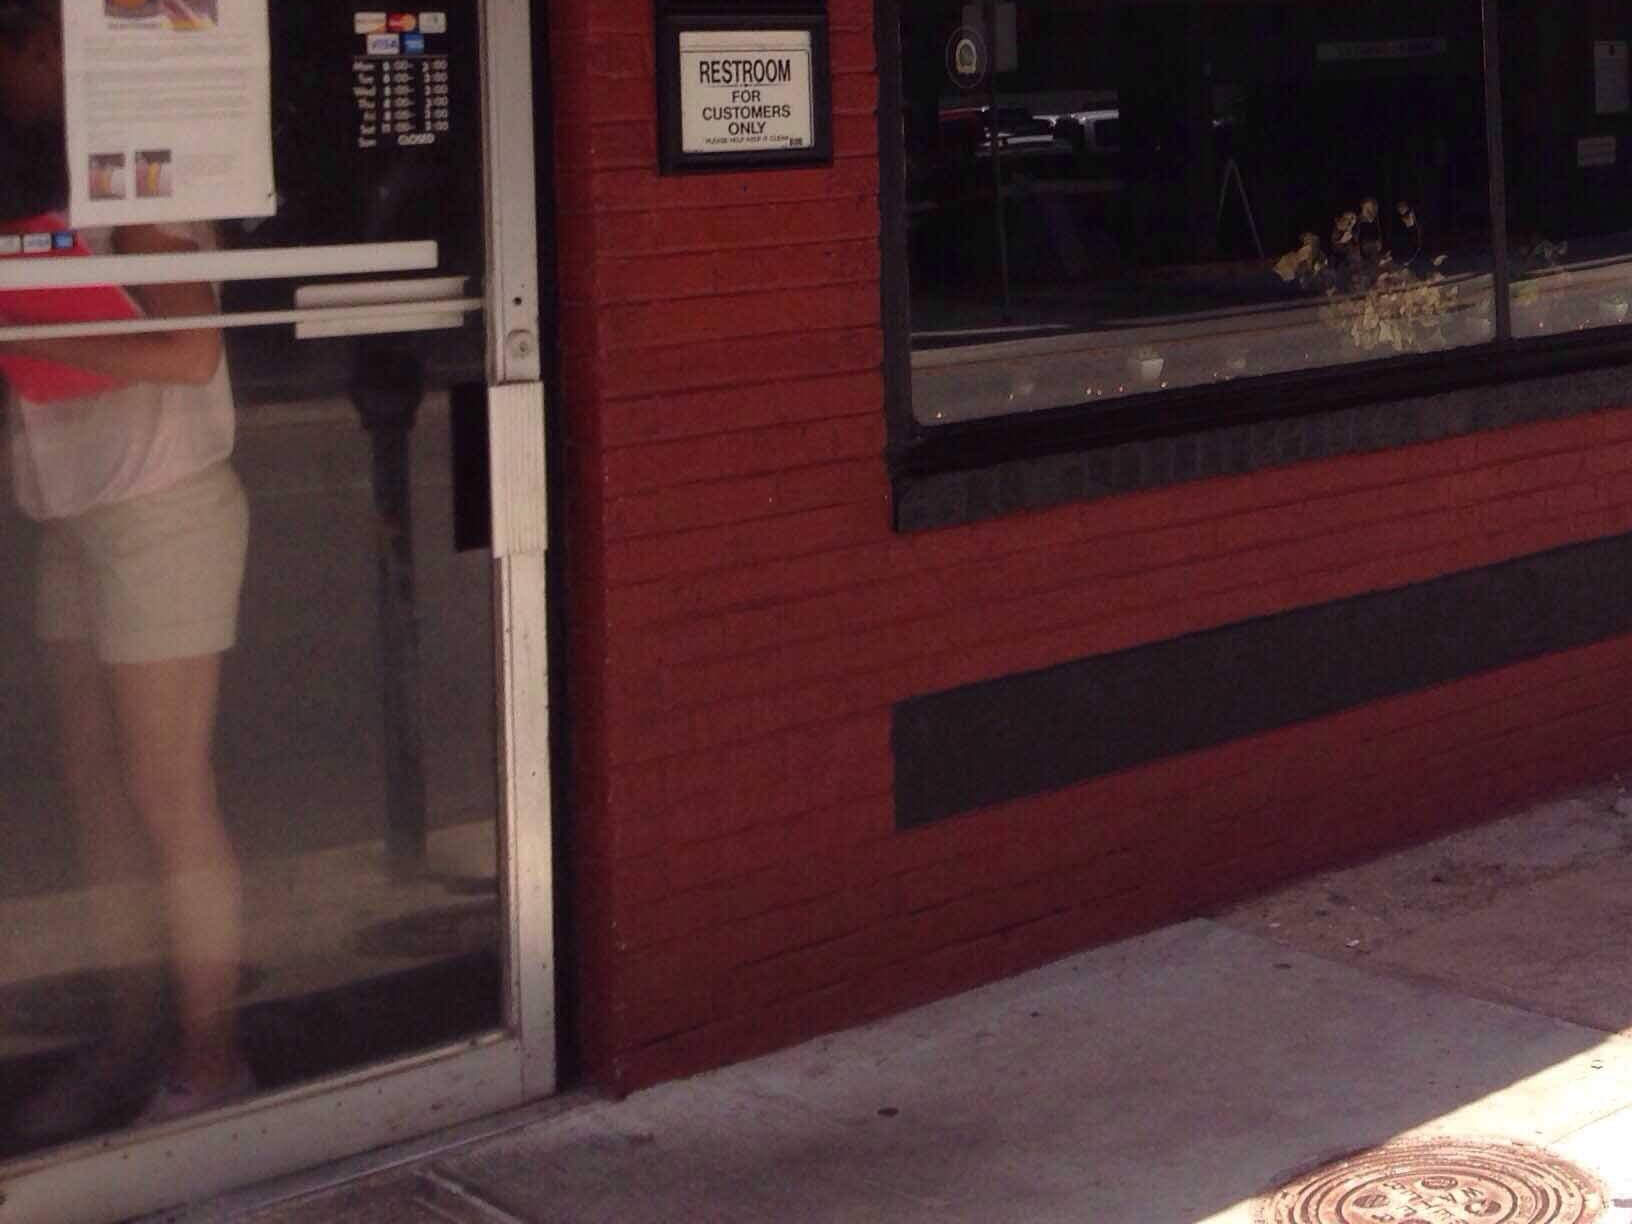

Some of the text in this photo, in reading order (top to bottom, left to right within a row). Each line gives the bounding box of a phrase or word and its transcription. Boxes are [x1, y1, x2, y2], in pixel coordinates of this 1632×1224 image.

[699, 59, 792, 84] RESTROOM
[732, 90, 761, 103] FOR
[702, 105, 791, 120] CUSTOMERS
[728, 122, 766, 136] ONLY
